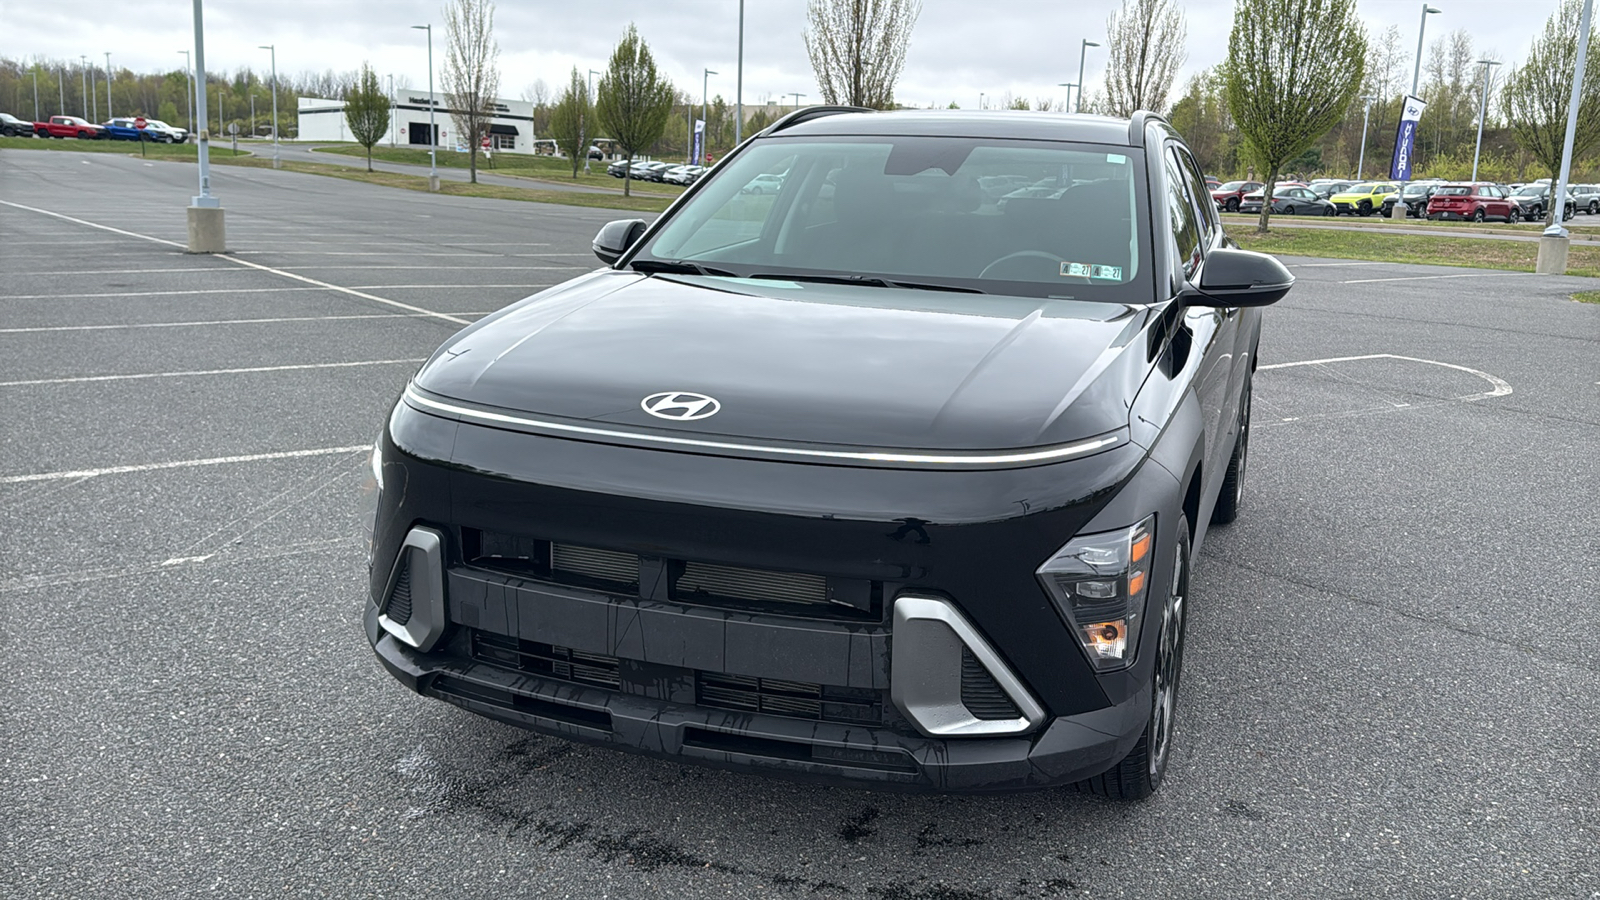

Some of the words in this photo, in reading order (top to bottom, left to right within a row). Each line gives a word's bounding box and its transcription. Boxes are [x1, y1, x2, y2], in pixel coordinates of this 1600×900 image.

[1398, 123, 1413, 178] HYUNDAI
[1081, 265, 1090, 275] 27
[1112, 268, 1120, 278] 27
